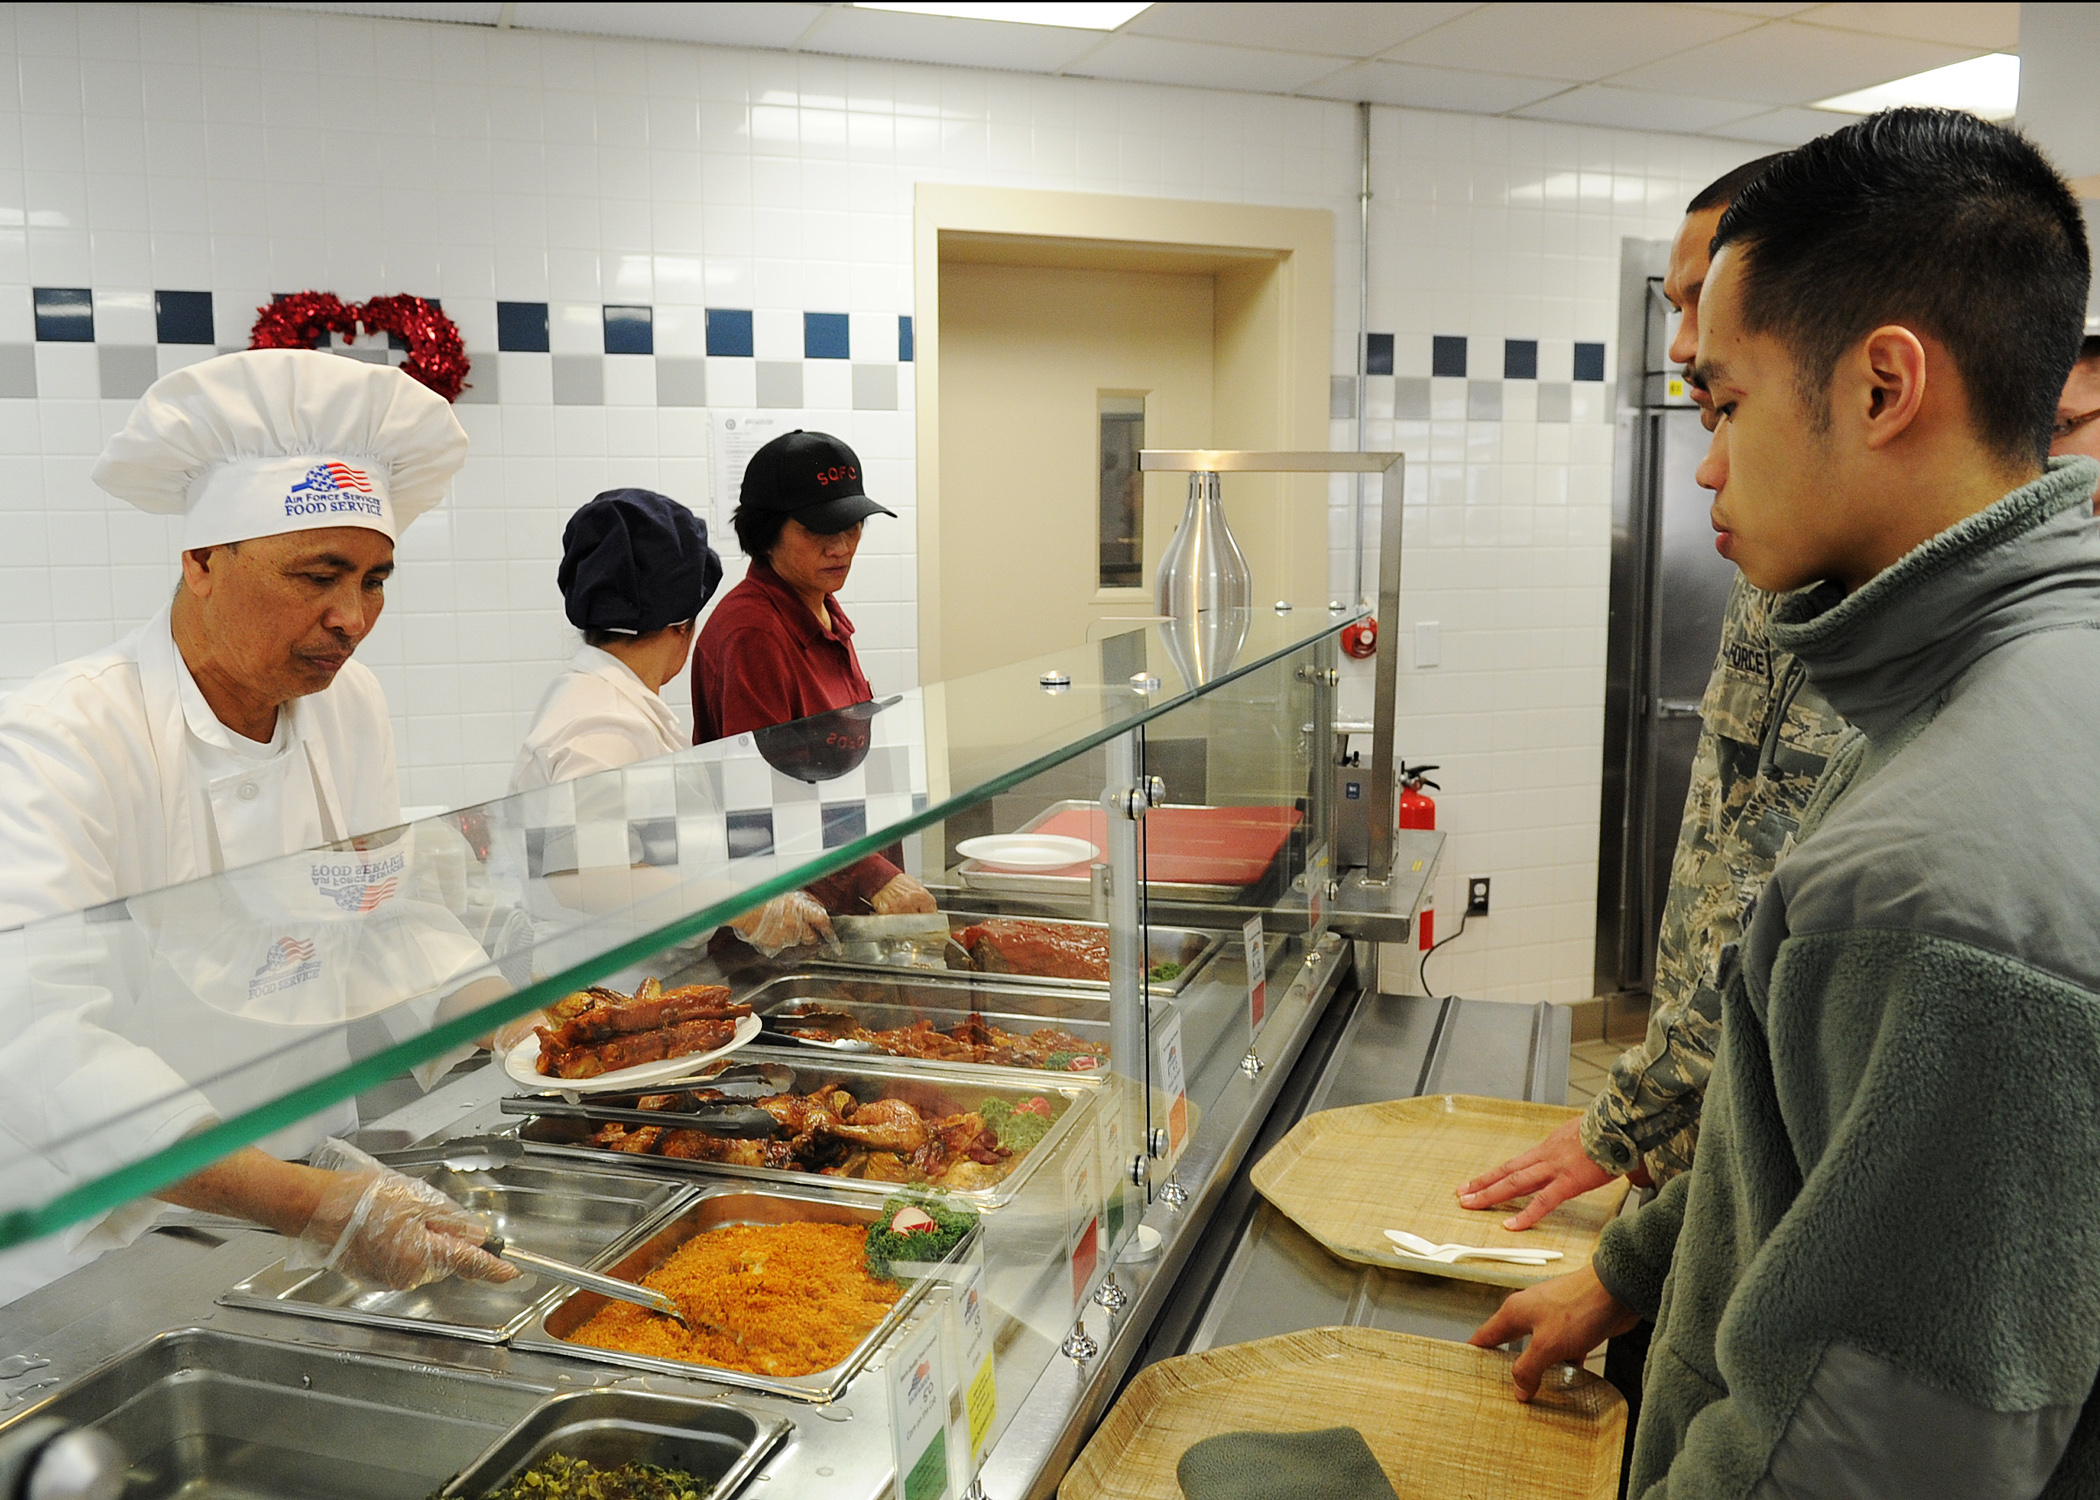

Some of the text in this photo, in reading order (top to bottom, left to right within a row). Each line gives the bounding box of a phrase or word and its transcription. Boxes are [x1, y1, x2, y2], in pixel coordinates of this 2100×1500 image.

[285, 496, 302, 504] AIR
[306, 493, 340, 501] FORCE
[285, 501, 382, 517] FOOD SERVICE
[1728, 642, 1765, 675] FORCE
